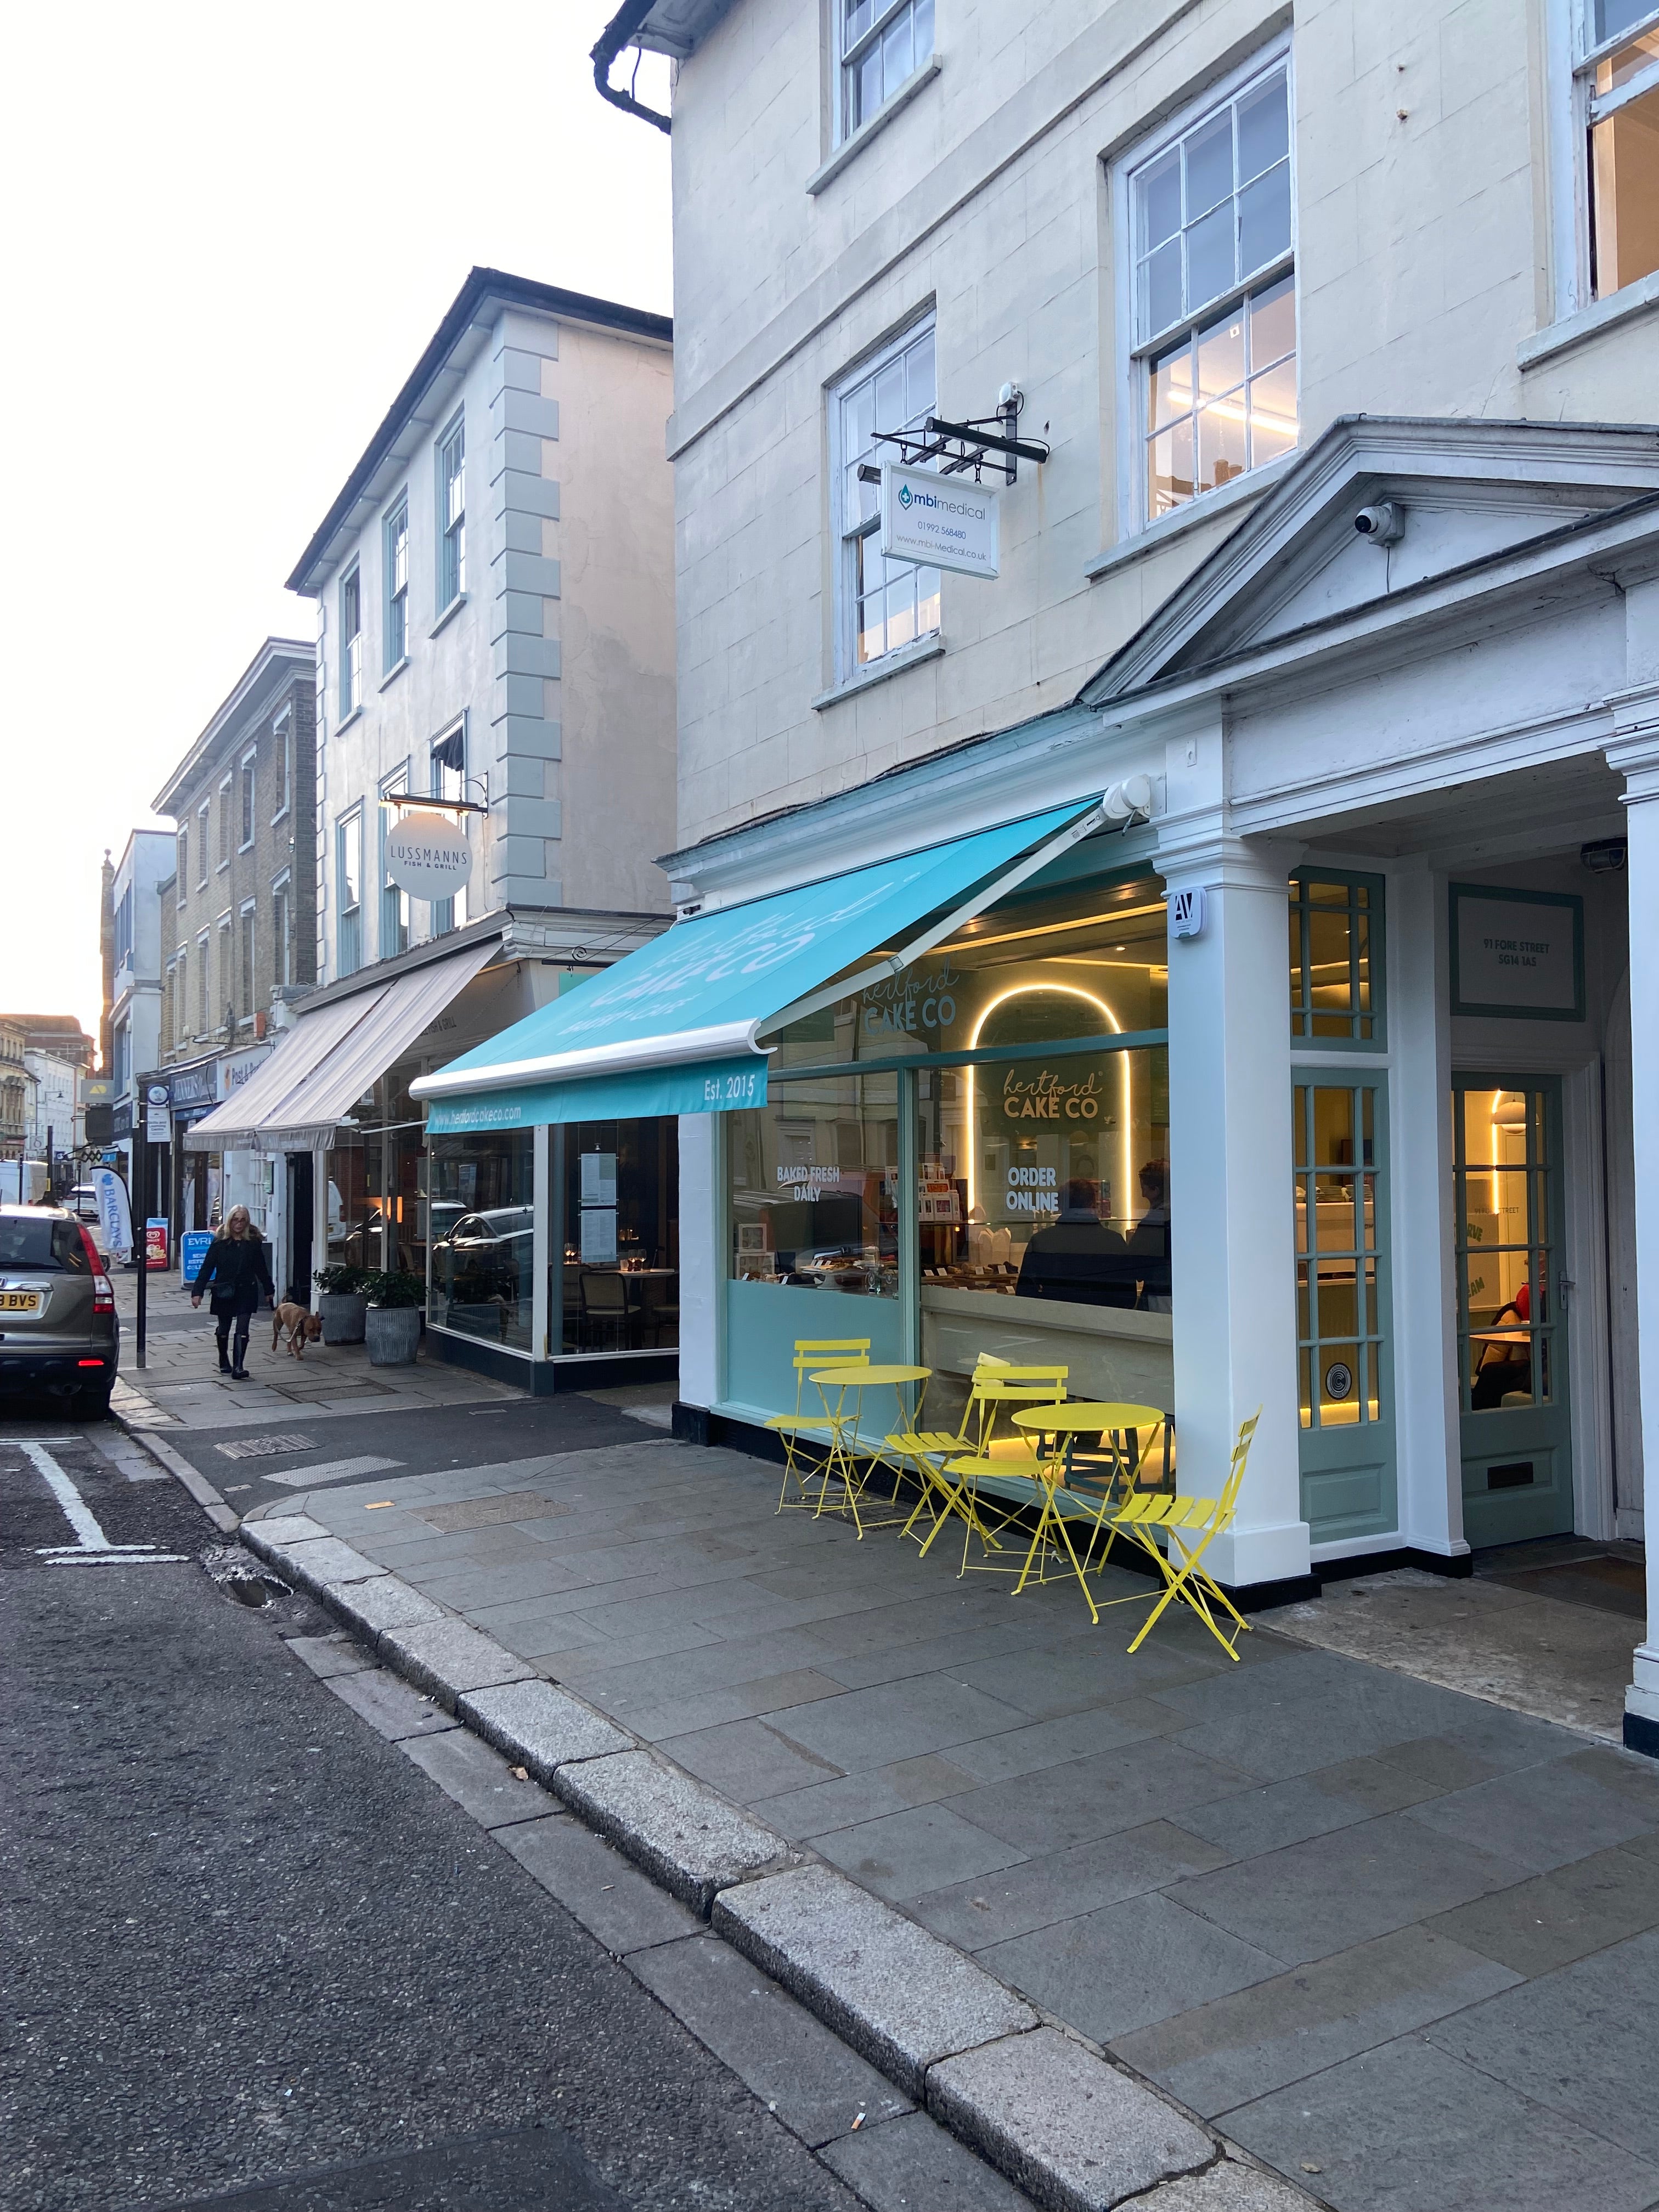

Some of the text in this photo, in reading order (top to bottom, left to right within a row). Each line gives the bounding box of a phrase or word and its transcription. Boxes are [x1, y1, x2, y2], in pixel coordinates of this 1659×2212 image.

[914, 493, 985, 520] mbimedical
[917, 521, 967, 540] 01992 568480
[896, 535, 986, 561] www.mbi-Medical.co.uk
[391, 845, 467, 865] LUSSMANNS
[1483, 938, 1550, 954] 91 FORE STREET
[706, 932, 816, 982] CO
[1498, 954, 1519, 966] SG14
[865, 995, 956, 1036] CAKE CO
[704, 1074, 755, 1101] Est. 2015
[1003, 1069, 1103, 1098] hertford
[435, 1106, 521, 1125] www.hertfordcakeco.com
[1004, 1097, 1098, 1119] CAKE CO
[777, 1166, 840, 1182] BAKED FRESH
[1008, 1167, 1056, 1187] ORDER
[794, 1186, 821, 1202] DAILY
[1006, 1190, 1059, 1211] ONLINE
[104, 1189, 122, 1248] BARCLAYS
[9, 1295, 36, 1306] BVS
